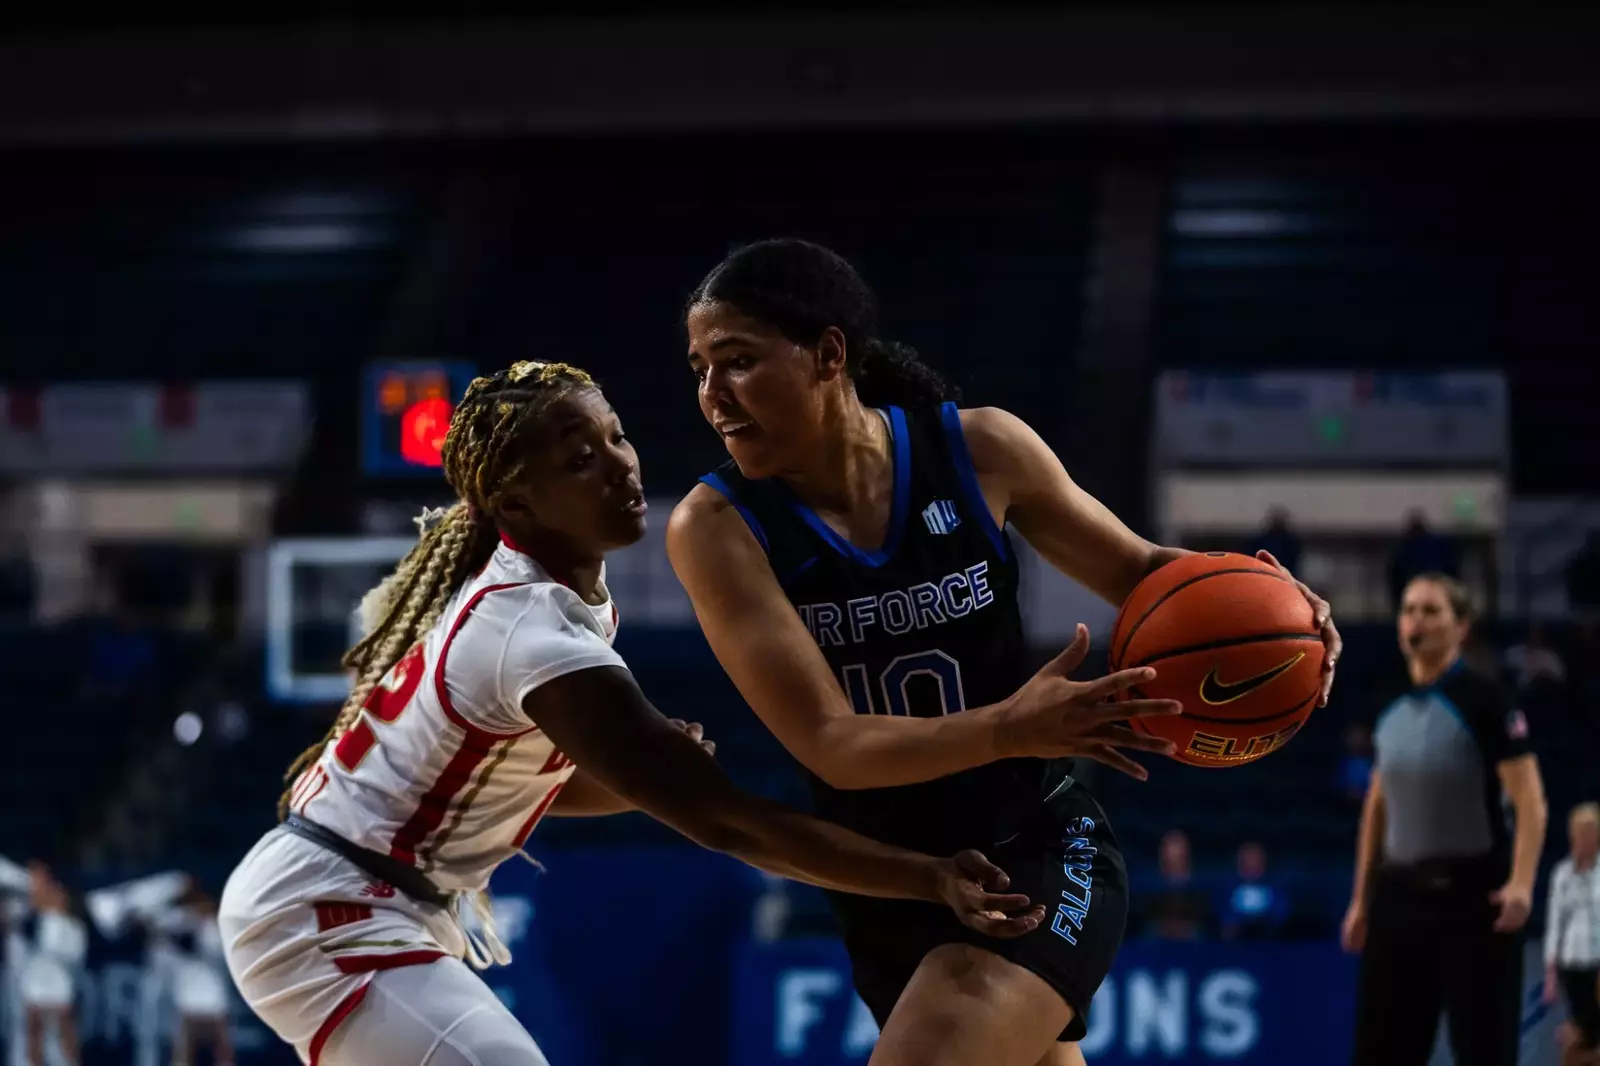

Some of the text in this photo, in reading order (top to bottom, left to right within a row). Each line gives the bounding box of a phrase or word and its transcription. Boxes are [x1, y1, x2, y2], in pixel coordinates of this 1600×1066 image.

[798, 560, 995, 647] IR FORCE
[842, 648, 966, 717] 10
[1050, 816, 1098, 946] FALCONS
